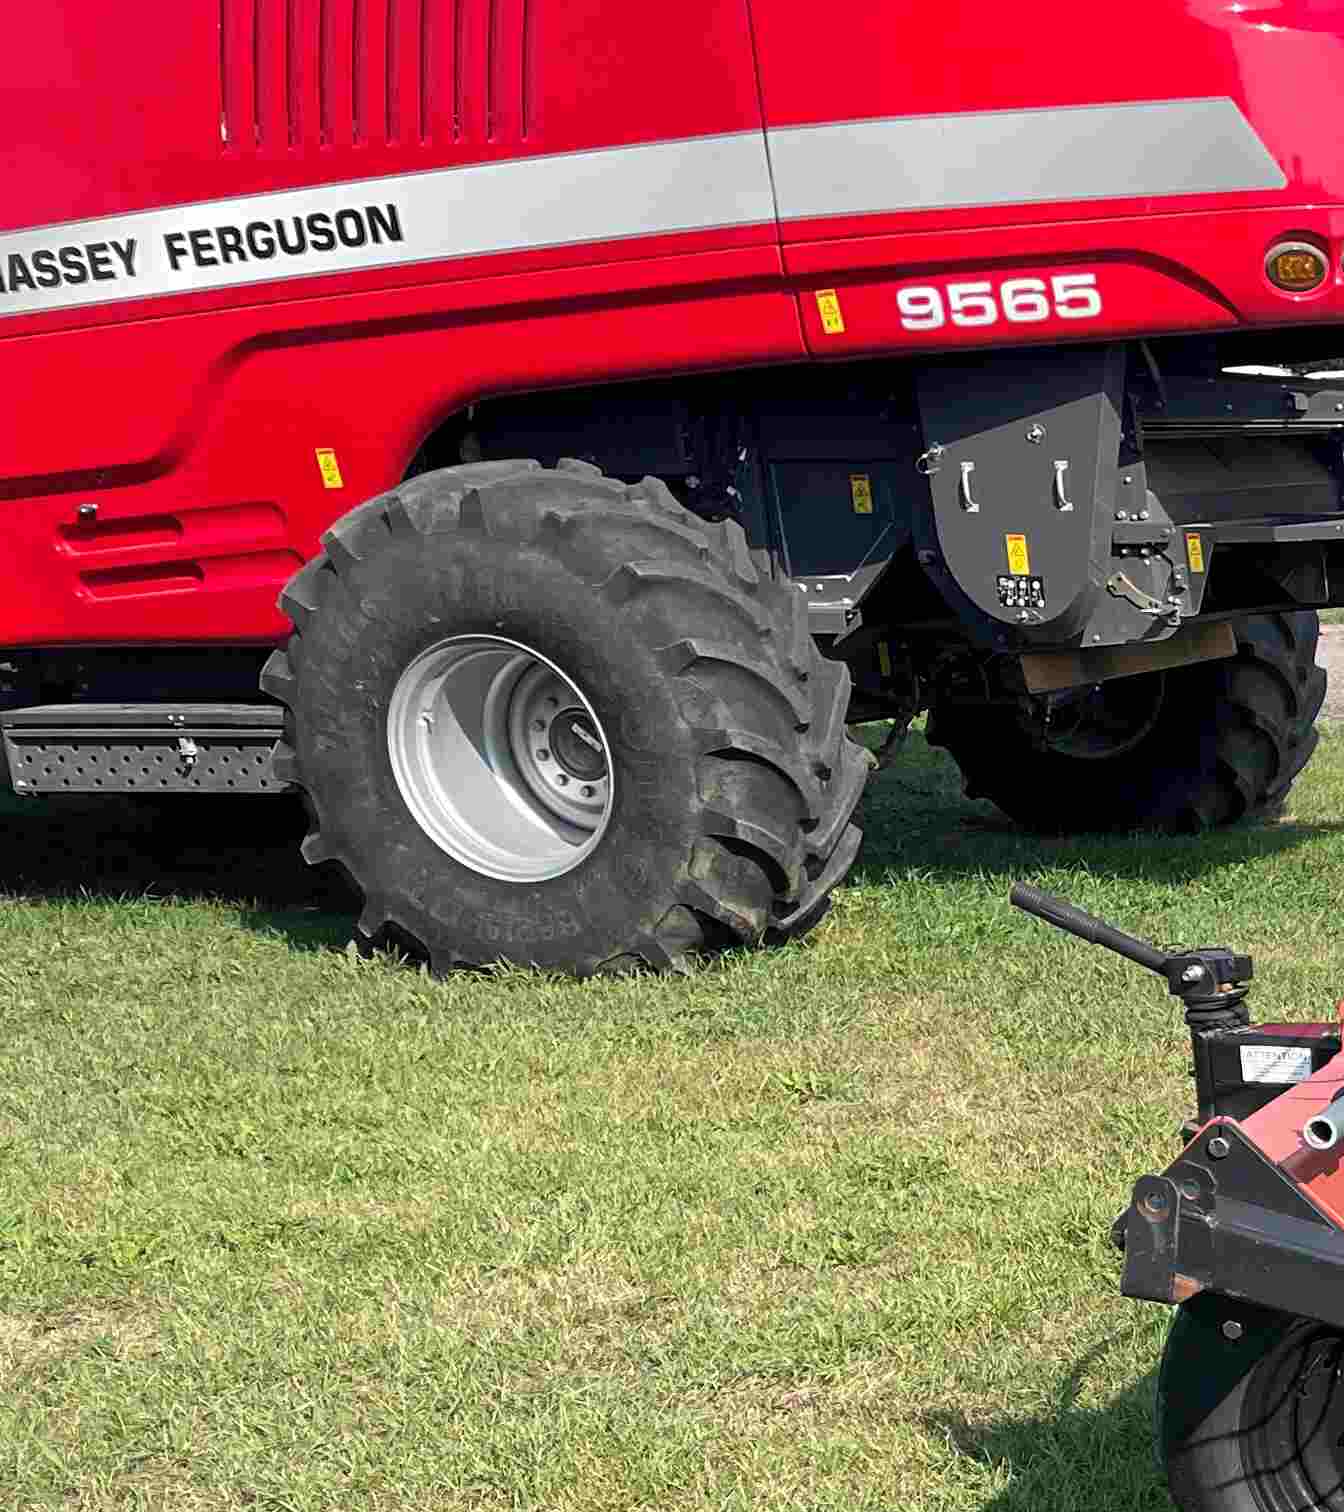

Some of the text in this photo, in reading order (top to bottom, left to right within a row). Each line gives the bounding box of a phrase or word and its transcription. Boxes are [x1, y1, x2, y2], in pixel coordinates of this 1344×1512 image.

[0, 203, 403, 295] ASSEY FERGUSON
[896, 273, 1103, 332] 9565
